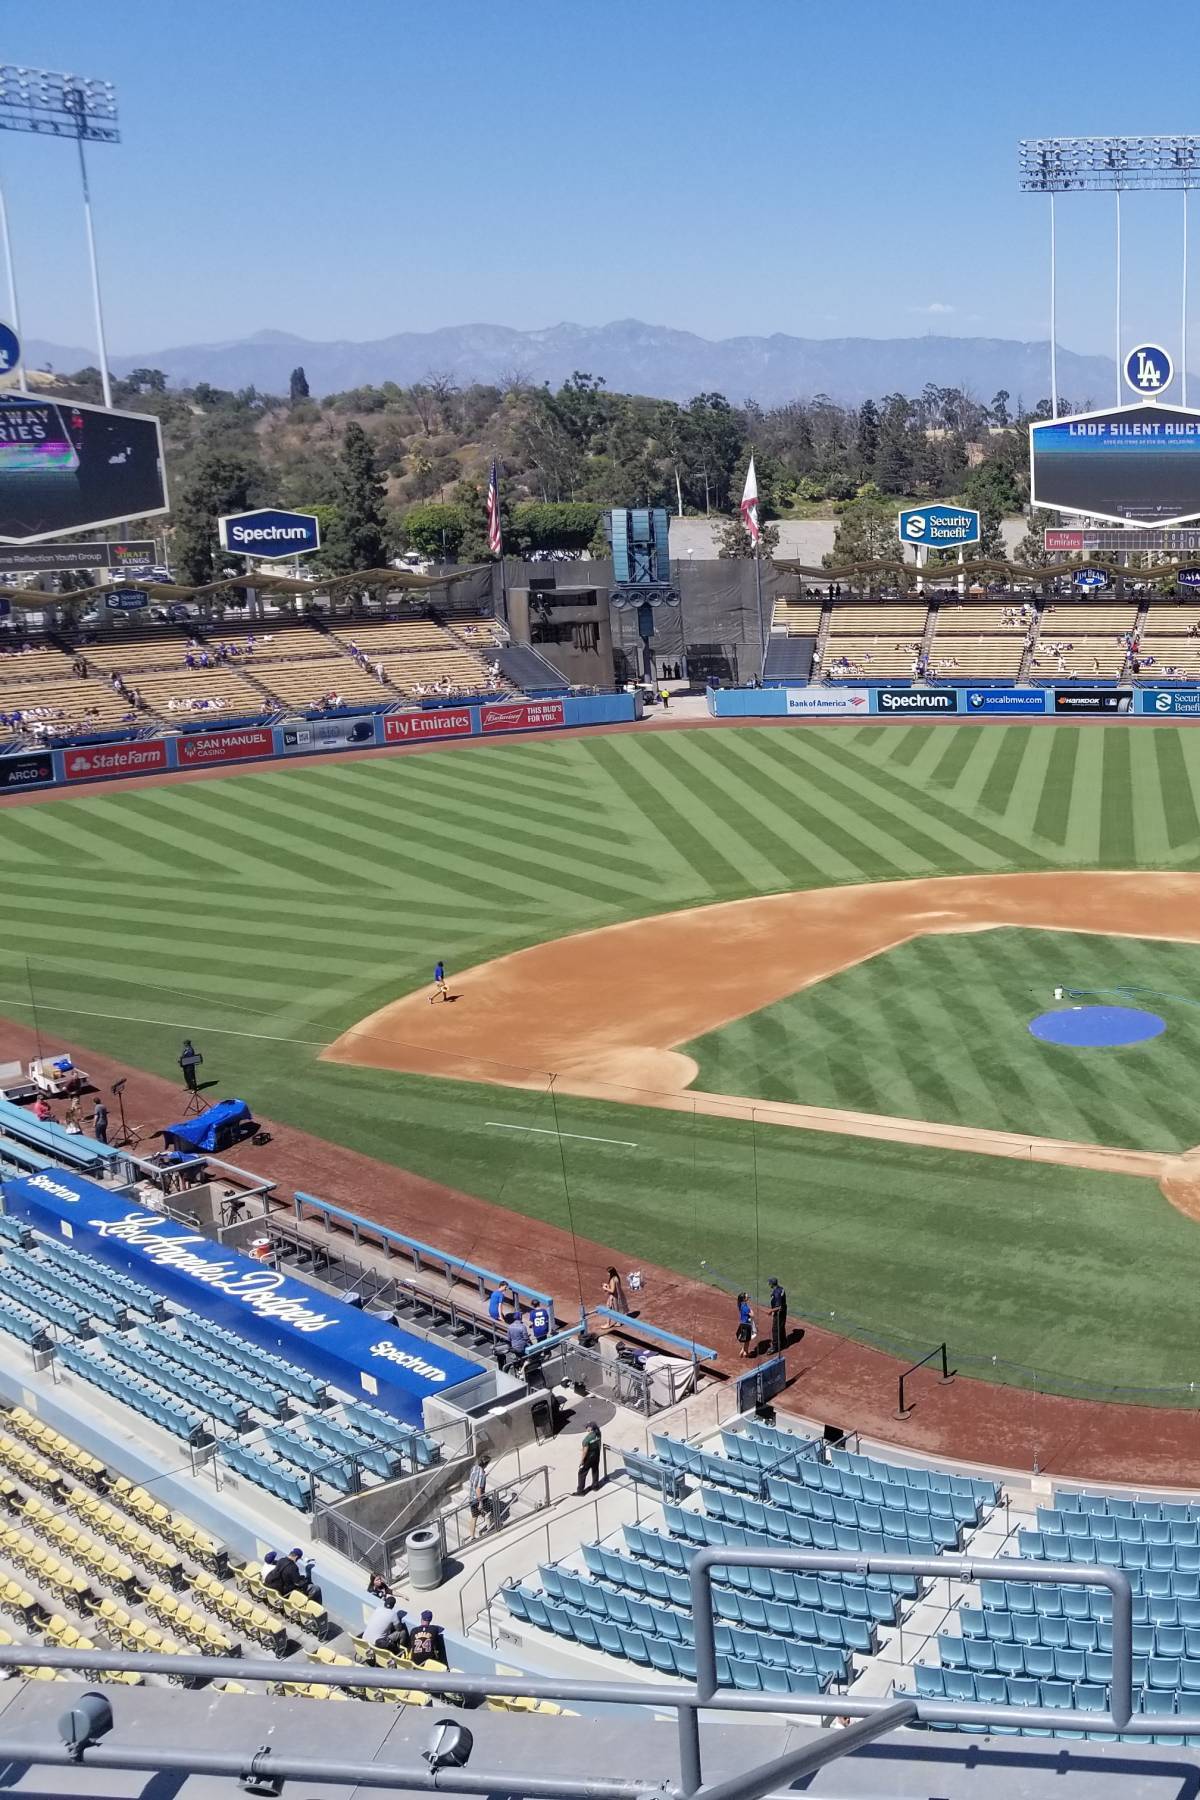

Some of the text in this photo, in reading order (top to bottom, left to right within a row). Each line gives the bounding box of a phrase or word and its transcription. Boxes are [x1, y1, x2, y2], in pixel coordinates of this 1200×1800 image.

[1137, 352, 1162, 387] LA
[1110, 423, 1161, 436] SILENT
[929, 516, 972, 538] Security Benefit
[232, 527, 307, 543] Spectrum
[1049, 538, 1081, 546] Emirates
[789, 699, 807, 708] Bank
[817, 699, 847, 708] America
[882, 694, 948, 709] Spectrum
[986, 695, 1042, 705] socalbmw.com
[527, 706, 542, 715] THIS
[387, 714, 469, 735] Fly Emirates
[528, 715, 541, 723] FOR
[197, 734, 266, 750] SAN MANUEL
[197, 748, 226, 757] CASINO
[9, 769, 38, 781] ARCO
[28, 1174, 81, 1202] Spectrum
[135, 1235, 236, 1286] Angeles
[216, 1270, 340, 1332] Dodgers
[534, 1316, 545, 1327] 66
[369, 1340, 447, 1382] Spectrum
[414, 1639, 432, 1653] 24
